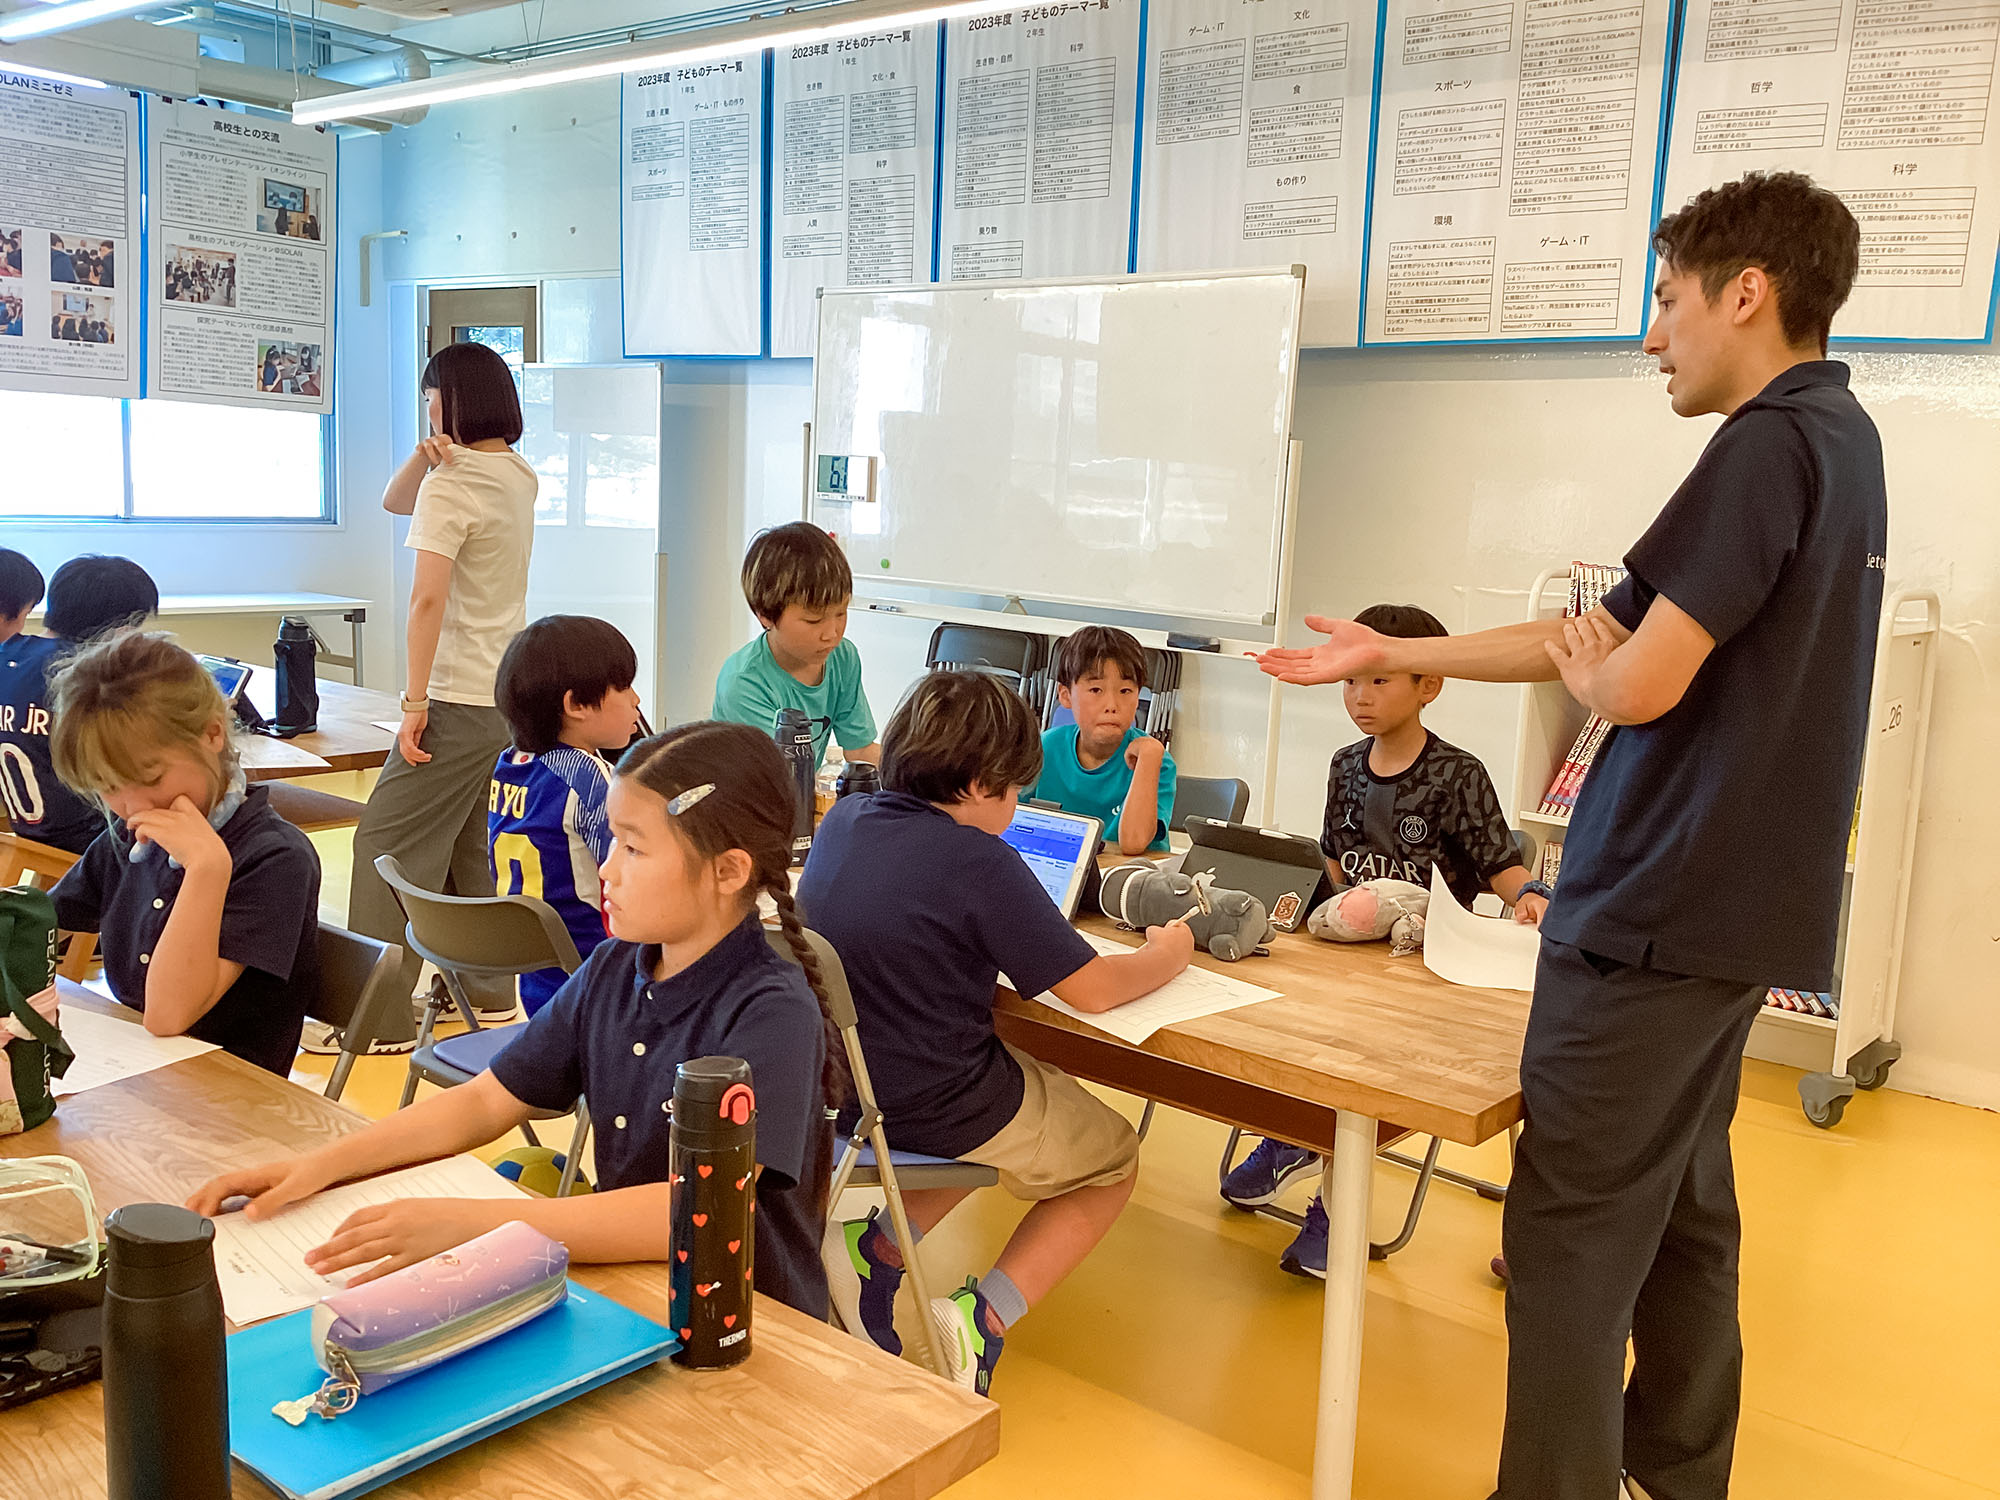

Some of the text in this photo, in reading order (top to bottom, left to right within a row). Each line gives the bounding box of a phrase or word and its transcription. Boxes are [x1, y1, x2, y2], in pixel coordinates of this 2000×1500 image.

[968, 0, 1109, 31] 2023年度 子どものテーマ一覧
[1294, 9, 1310, 21] 文化
[1026, 28, 1045, 38] 2年生
[1188, 22, 1225, 37] ゲーム・IT
[792, 30, 911, 59] 2023年度 子どものテーマ一覧
[1070, 43, 1084, 53] 科学
[975, 54, 1013, 68] 生き物・自然
[638, 61, 743, 87] 2023年度 子どものテーマ一覧
[1293, 84, 1301, 95] 食
[1434, 79, 1472, 92] スポーツ
[1751, 81, 1773, 93] 哲学
[213, 120, 280, 144] 高校生との交流
[876, 160, 888, 168] 科学
[1892, 163, 1918, 176] 科学
[648, 168, 667, 176] スポーツ
[1276, 175, 1306, 187] もの作り
[1433, 215, 1453, 226] 環境
[1540, 235, 1590, 247] ゲーム・IT
[1866, 552, 1885, 570] Seto
[1405, 817, 1424, 826] PARIS
[1340, 851, 1423, 882] QATAR
[719, 1330, 749, 1348] THERMOS
